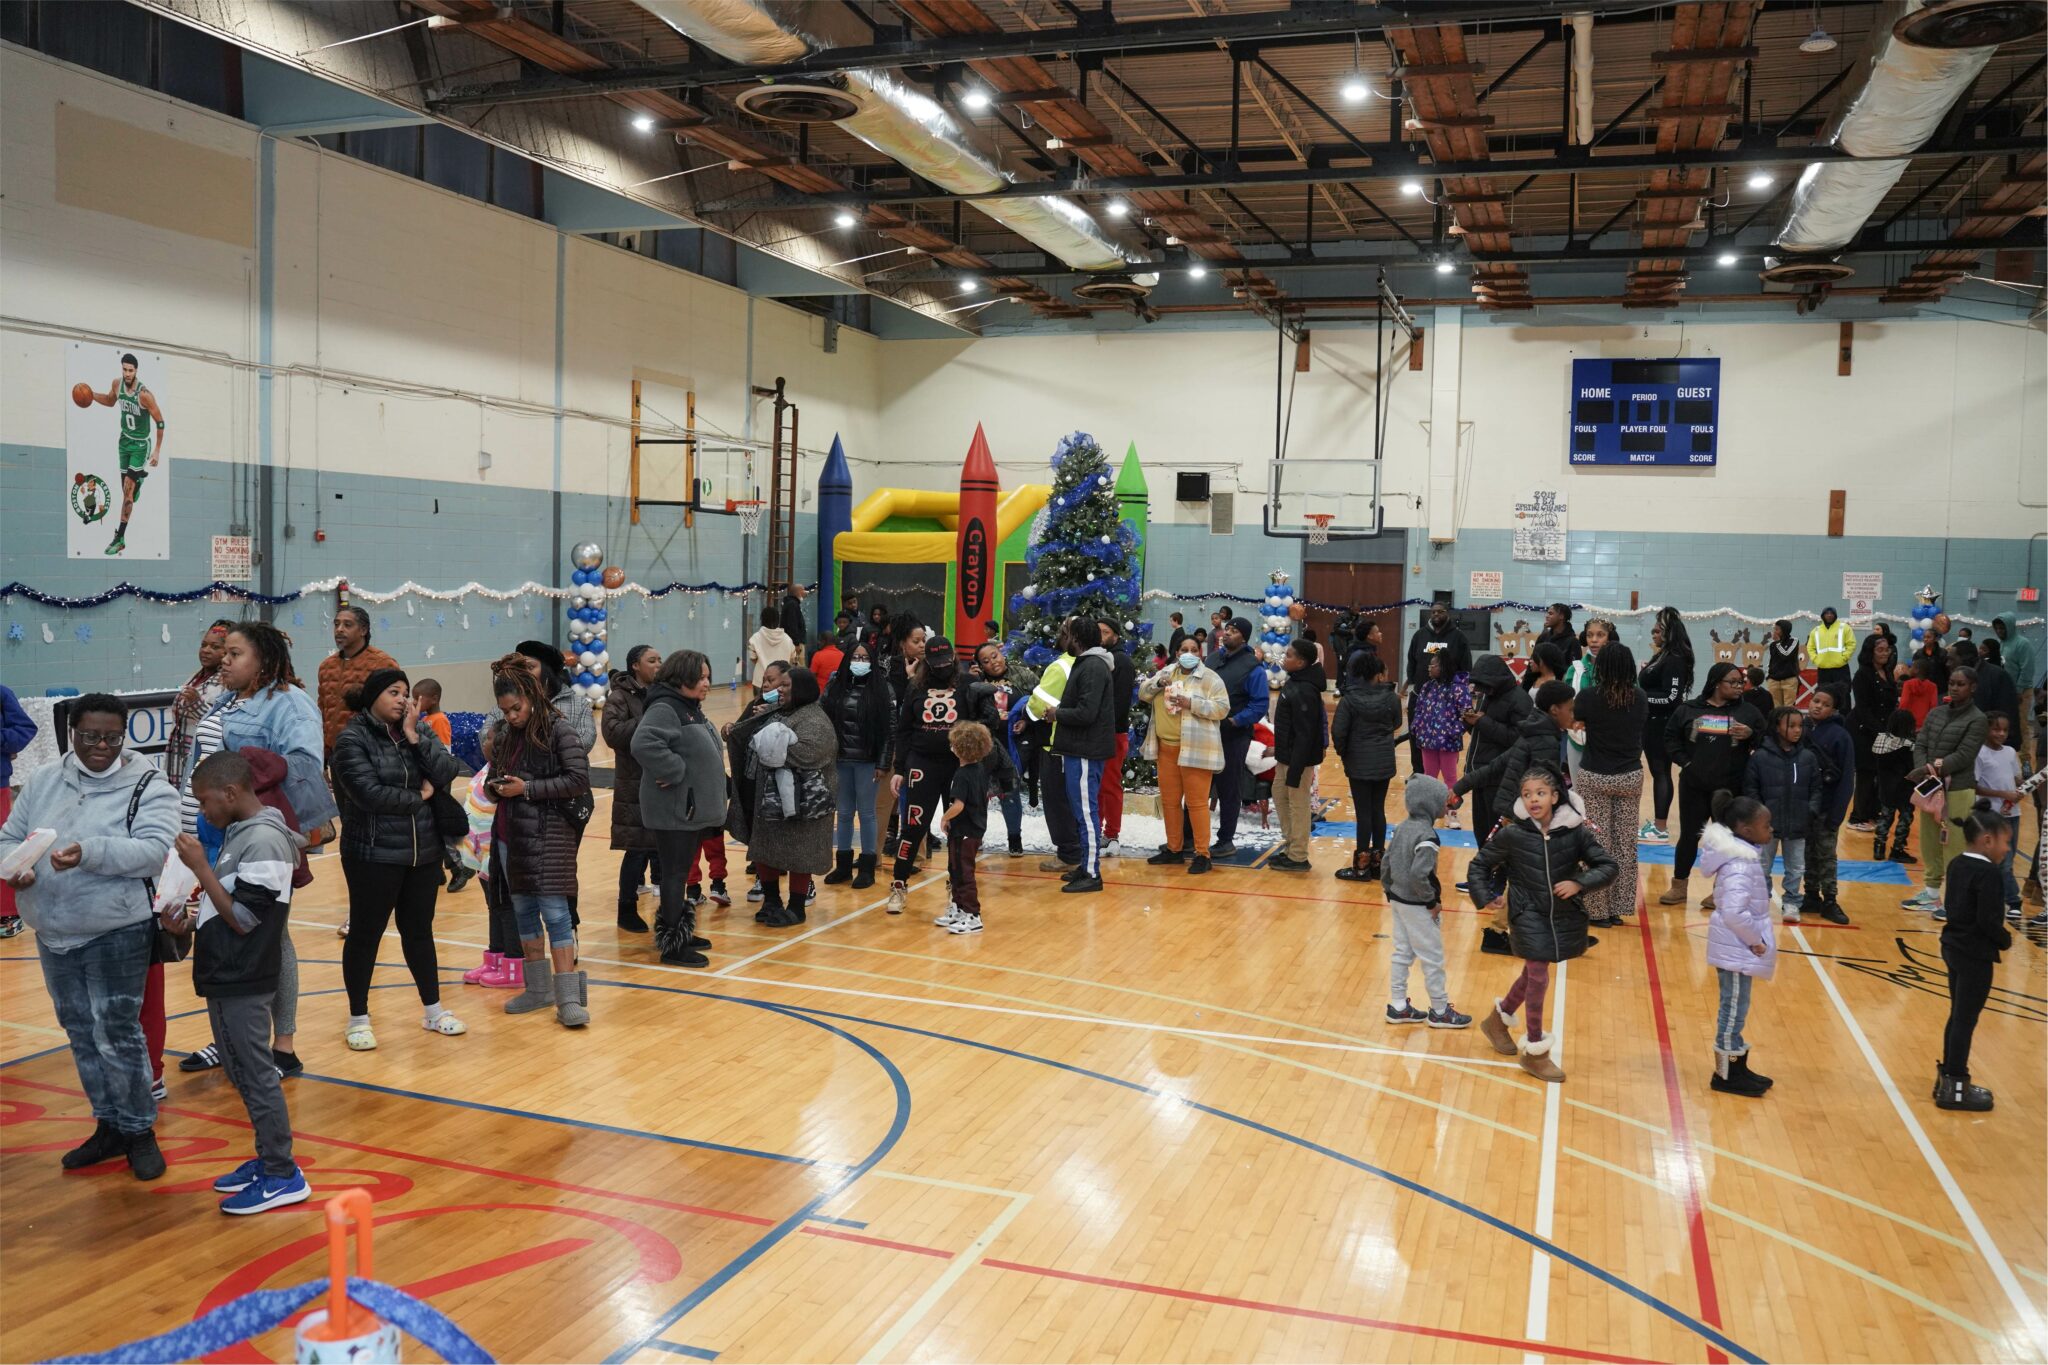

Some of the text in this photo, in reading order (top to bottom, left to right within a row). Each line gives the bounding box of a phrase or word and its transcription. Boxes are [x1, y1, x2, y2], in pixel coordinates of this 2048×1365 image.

[1581, 388, 1611, 399] HOME
[1632, 393, 1657, 401] PERIOD
[1677, 387, 1712, 398] GUEST
[1574, 425, 1597, 433] FOULS
[1620, 425, 1668, 433] PLAYER FOUL
[1690, 425, 1714, 433] FOULS
[1573, 453, 1596, 462] SCORE
[1630, 454, 1655, 462] MATCH
[1689, 454, 1713, 462] SCORE
[71, 484, 81, 514] BOSTON
[100, 481, 111, 510] CELTICS
[214, 537, 249, 546] GYM RULES
[214, 546, 249, 555] NO SMOKING
[966, 530, 982, 606] Crayon
[935, 705, 945, 717] P
